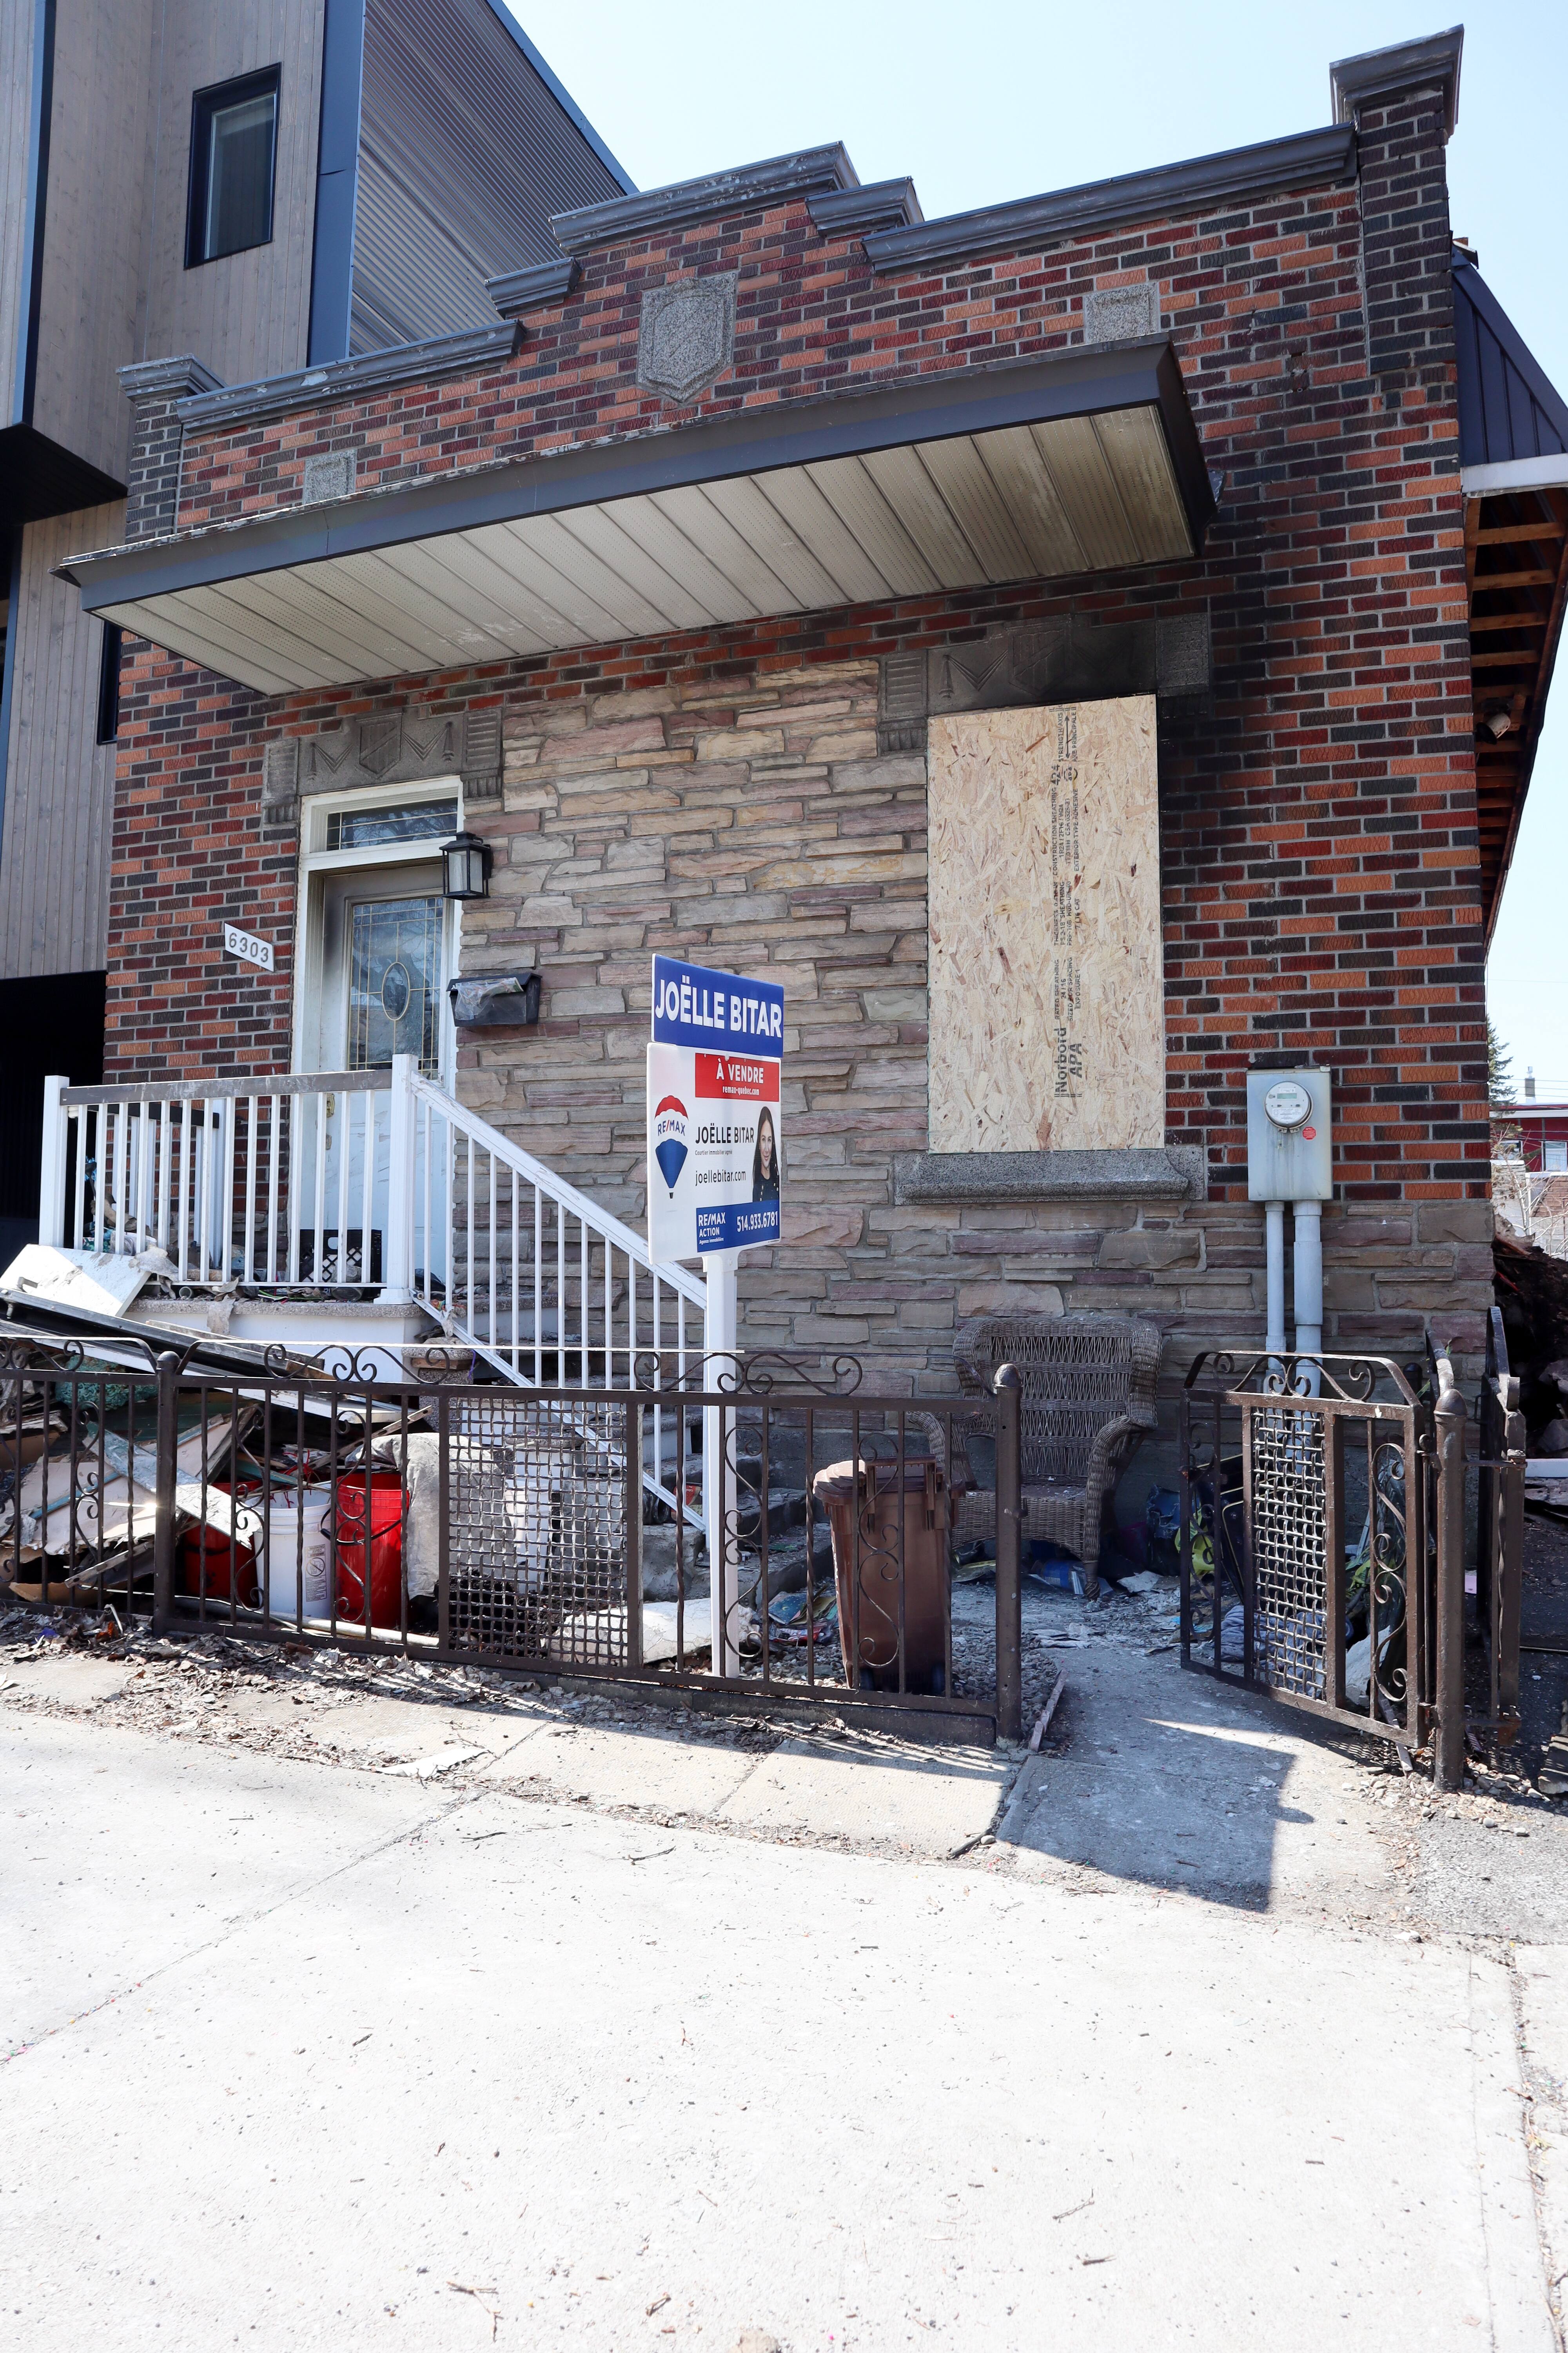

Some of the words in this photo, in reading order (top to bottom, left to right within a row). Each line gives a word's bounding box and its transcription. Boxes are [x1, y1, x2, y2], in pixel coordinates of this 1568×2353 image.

[229, 933, 269, 963] 6303
[655, 974, 725, 1029] JOËLLE
[730, 995, 782, 1038] BITAR
[1054, 1028, 1067, 1092] Norbord
[1069, 1043, 1082, 1078] APA
[716, 1058, 724, 1080] À
[728, 1063, 764, 1084] VENDRE
[722, 1086, 759, 1096] remax-quebec.com
[658, 1119, 685, 1136] RE/MAX
[695, 1123, 731, 1144] JOËLLE
[734, 1127, 755, 1143] BITAR
[695, 1169, 746, 1186] joellebitar.com
[698, 1212, 726, 1227] RE/MAX
[737, 1211, 778, 1232] 514.933.6781
[699, 1226, 720, 1237] ACTION
